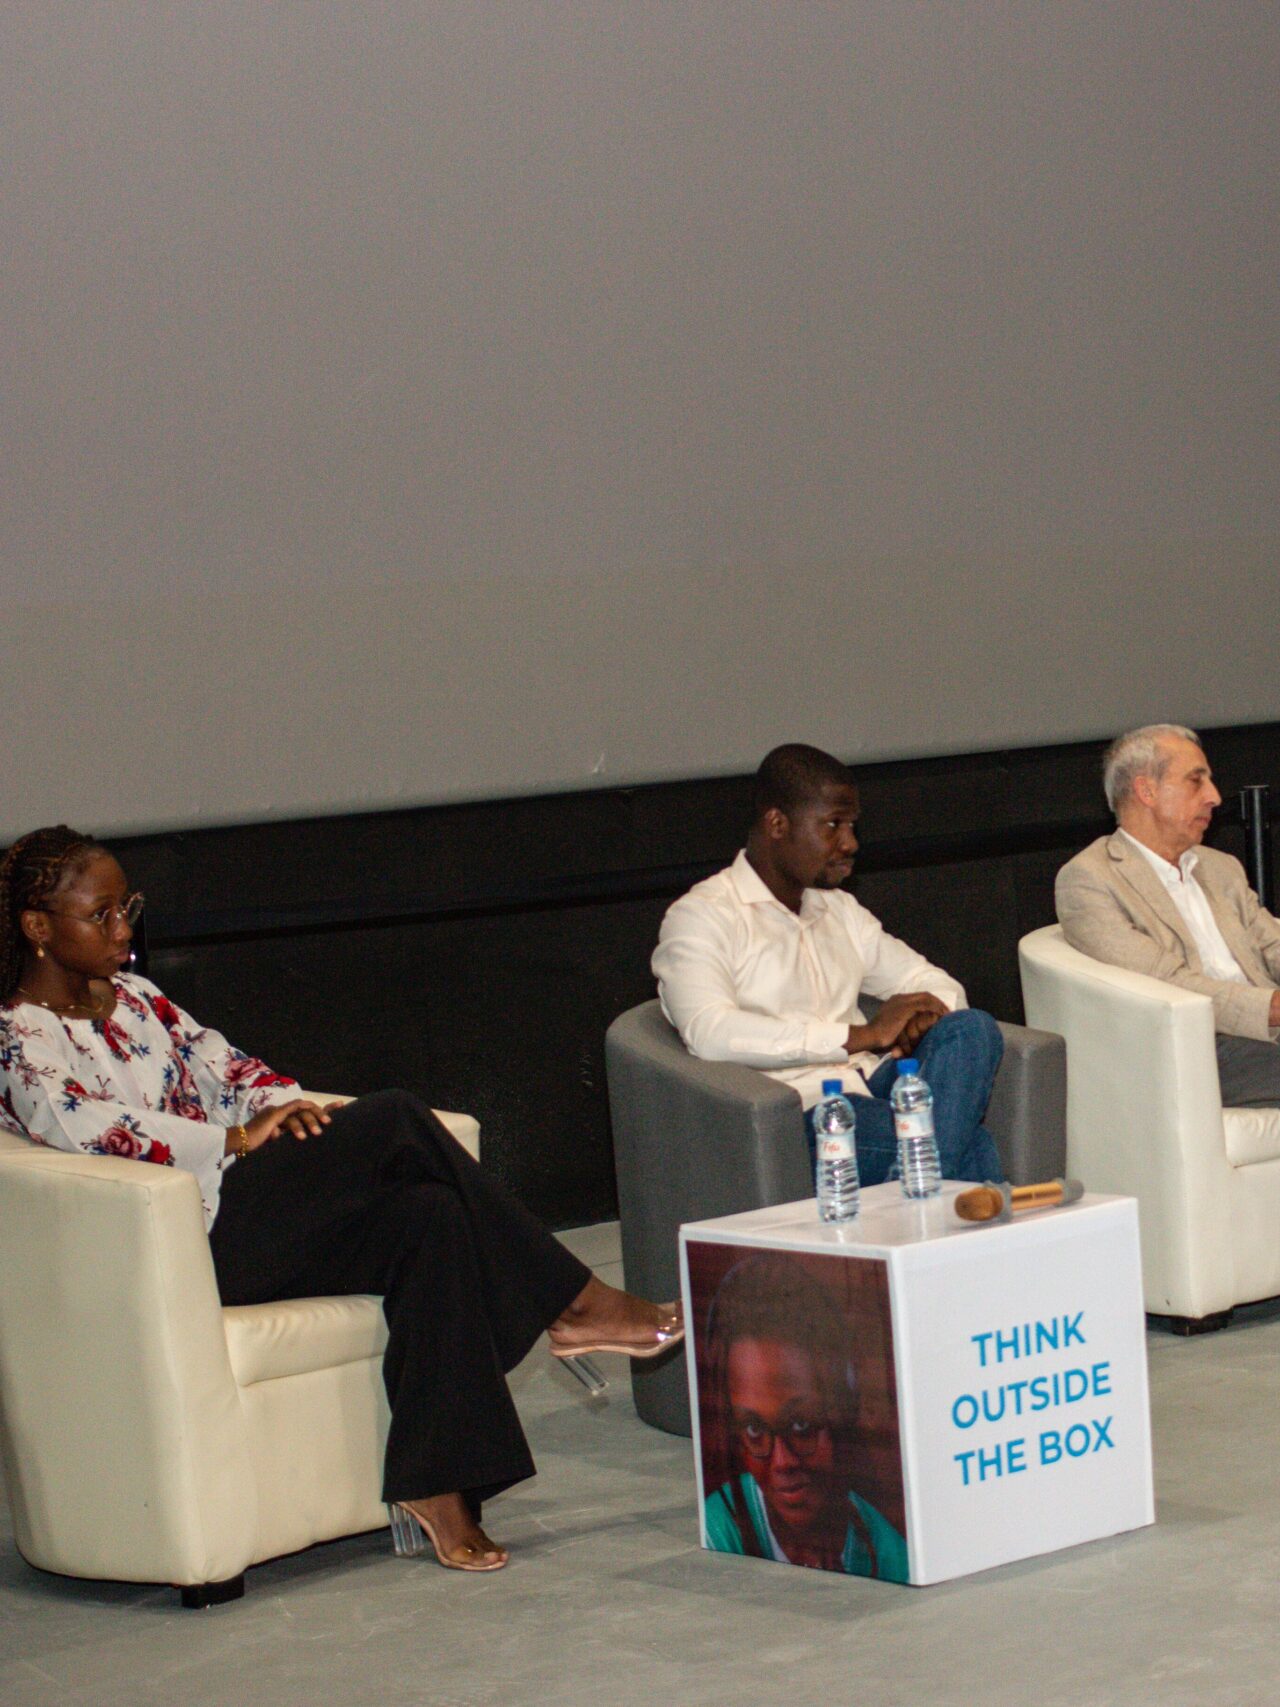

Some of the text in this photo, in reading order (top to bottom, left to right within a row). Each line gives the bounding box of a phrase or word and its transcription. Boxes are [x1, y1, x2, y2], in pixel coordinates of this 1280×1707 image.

[971, 1311, 1086, 1366] THINK
[952, 1361, 1112, 1428] OUTSIDE
[953, 1416, 1115, 1485] THE BOX
